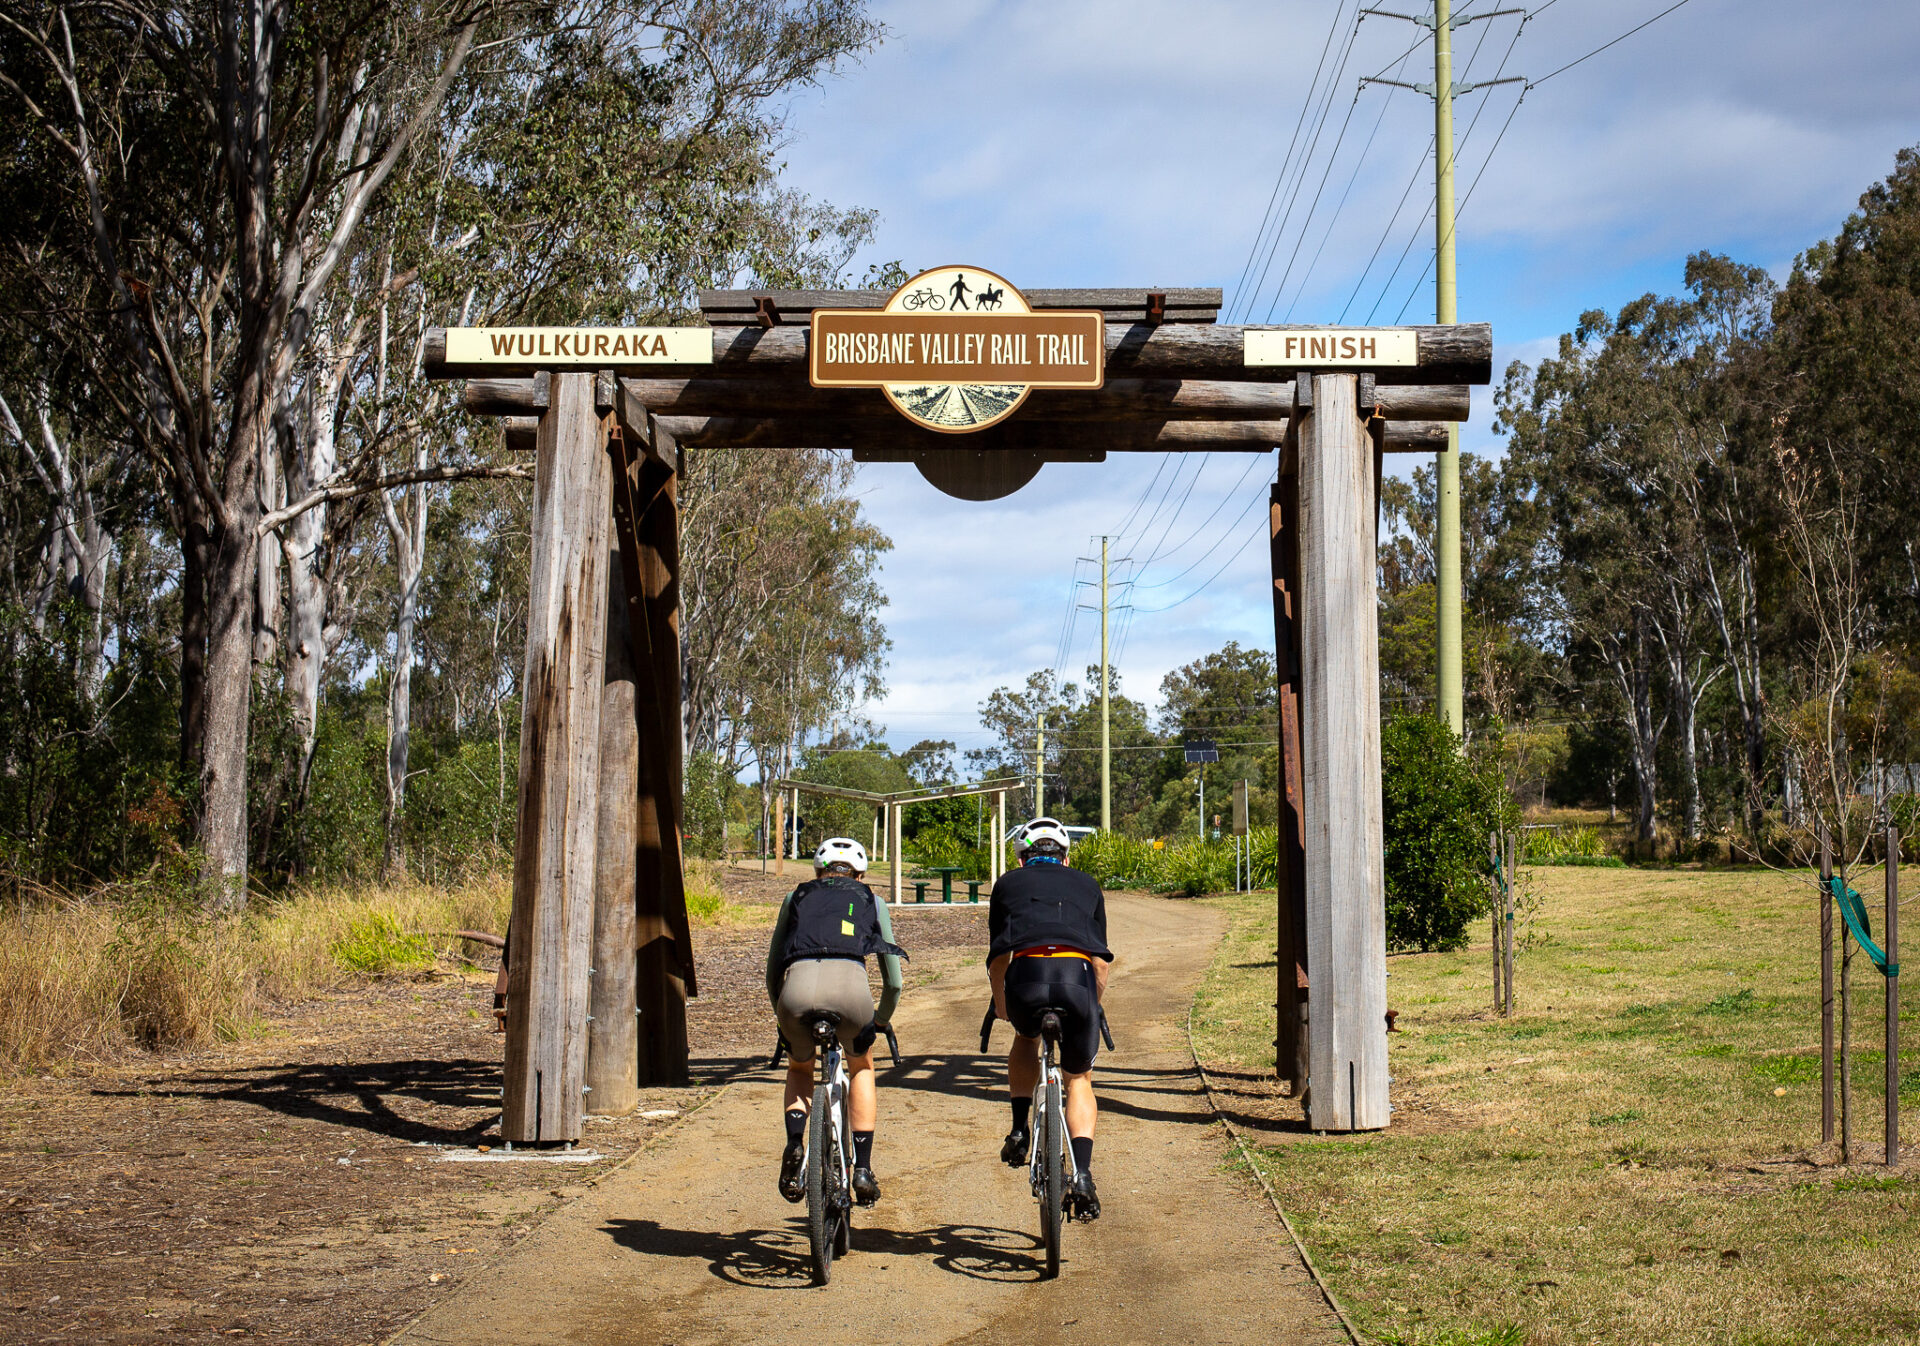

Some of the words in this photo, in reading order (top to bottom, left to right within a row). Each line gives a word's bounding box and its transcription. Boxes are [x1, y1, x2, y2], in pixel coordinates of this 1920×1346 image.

[490, 334, 669, 357] WULKURAKA
[826, 332, 915, 364] BRISBANE
[921, 333, 986, 365] VALLEY
[990, 334, 1032, 365] RAIL
[1036, 334, 1089, 365] TRAIL
[1285, 337, 1376, 359] FINISH
